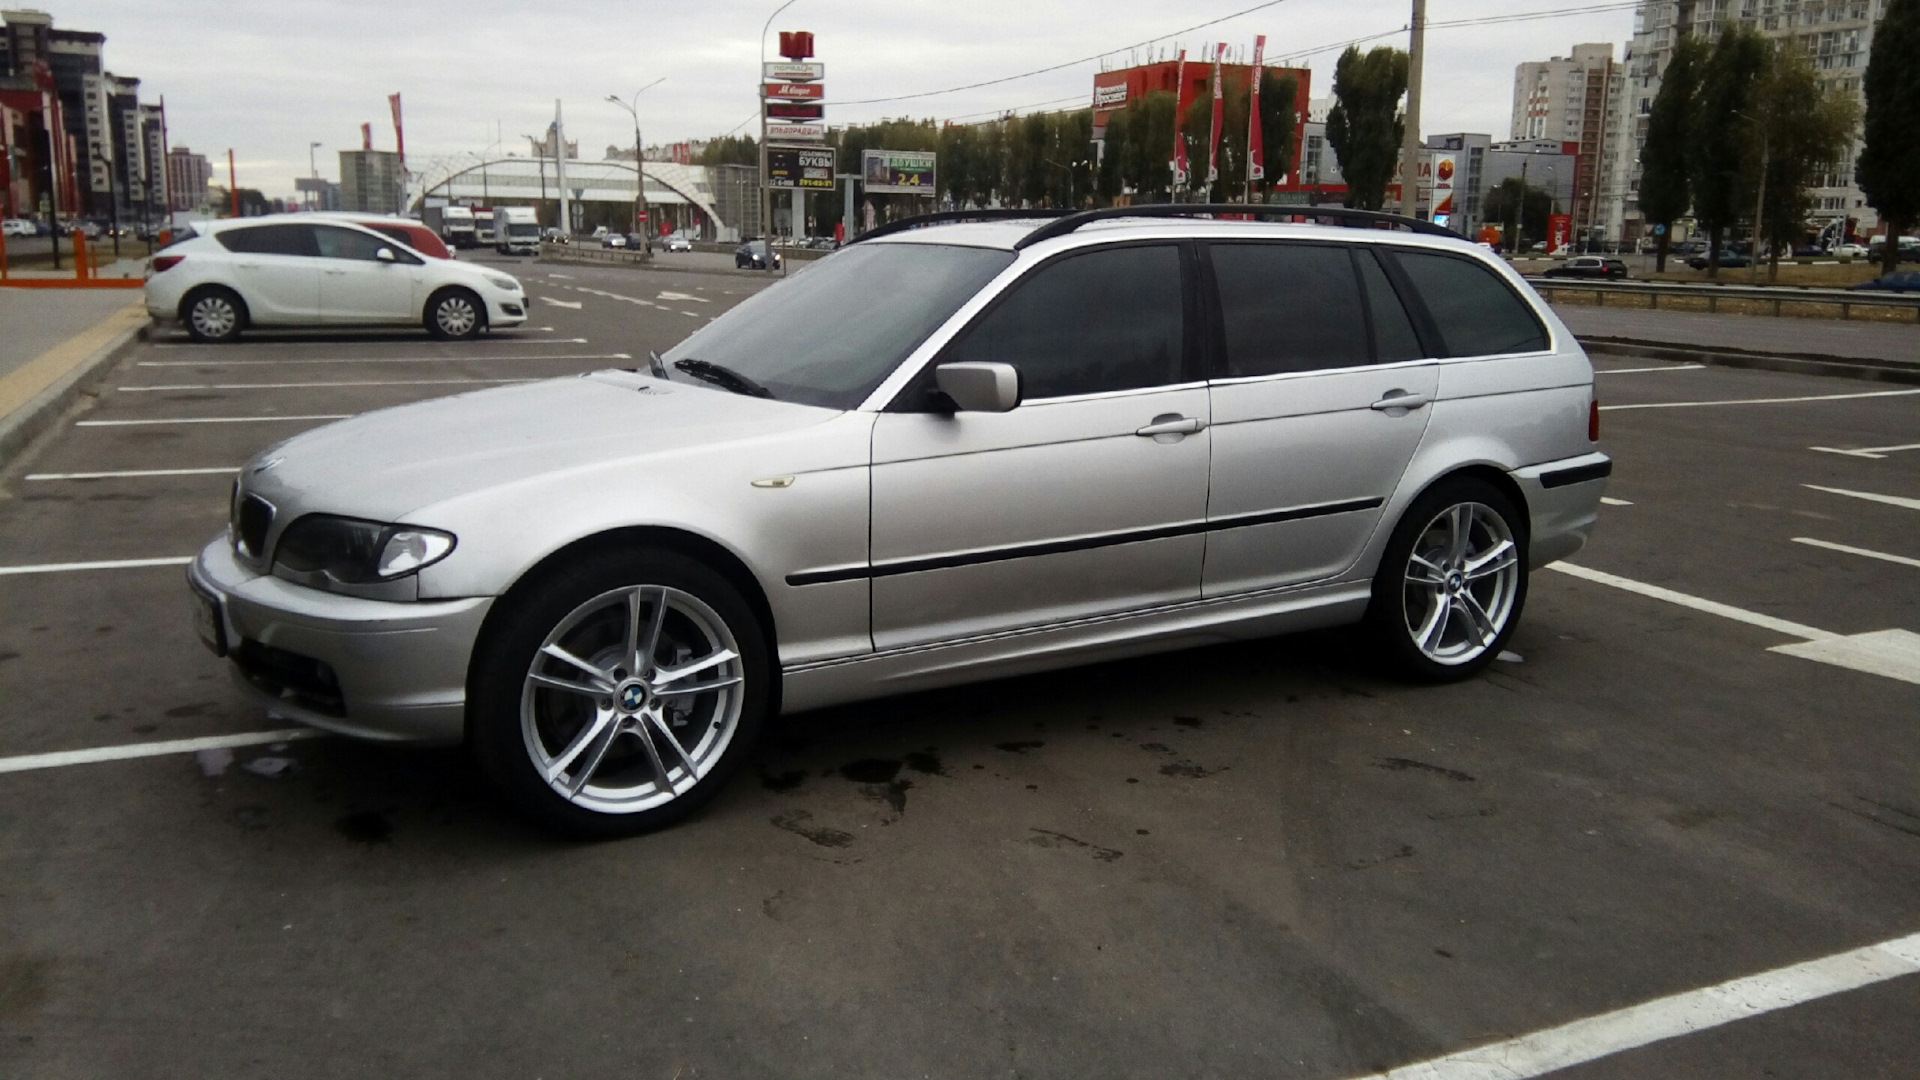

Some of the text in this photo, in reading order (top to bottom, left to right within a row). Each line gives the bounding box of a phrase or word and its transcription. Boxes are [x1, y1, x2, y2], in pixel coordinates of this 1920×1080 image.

[799, 157, 833, 168] БУКВЫ
[891, 158, 933, 168] ДВУШКИ
[898, 172, 920, 187] 2.4
